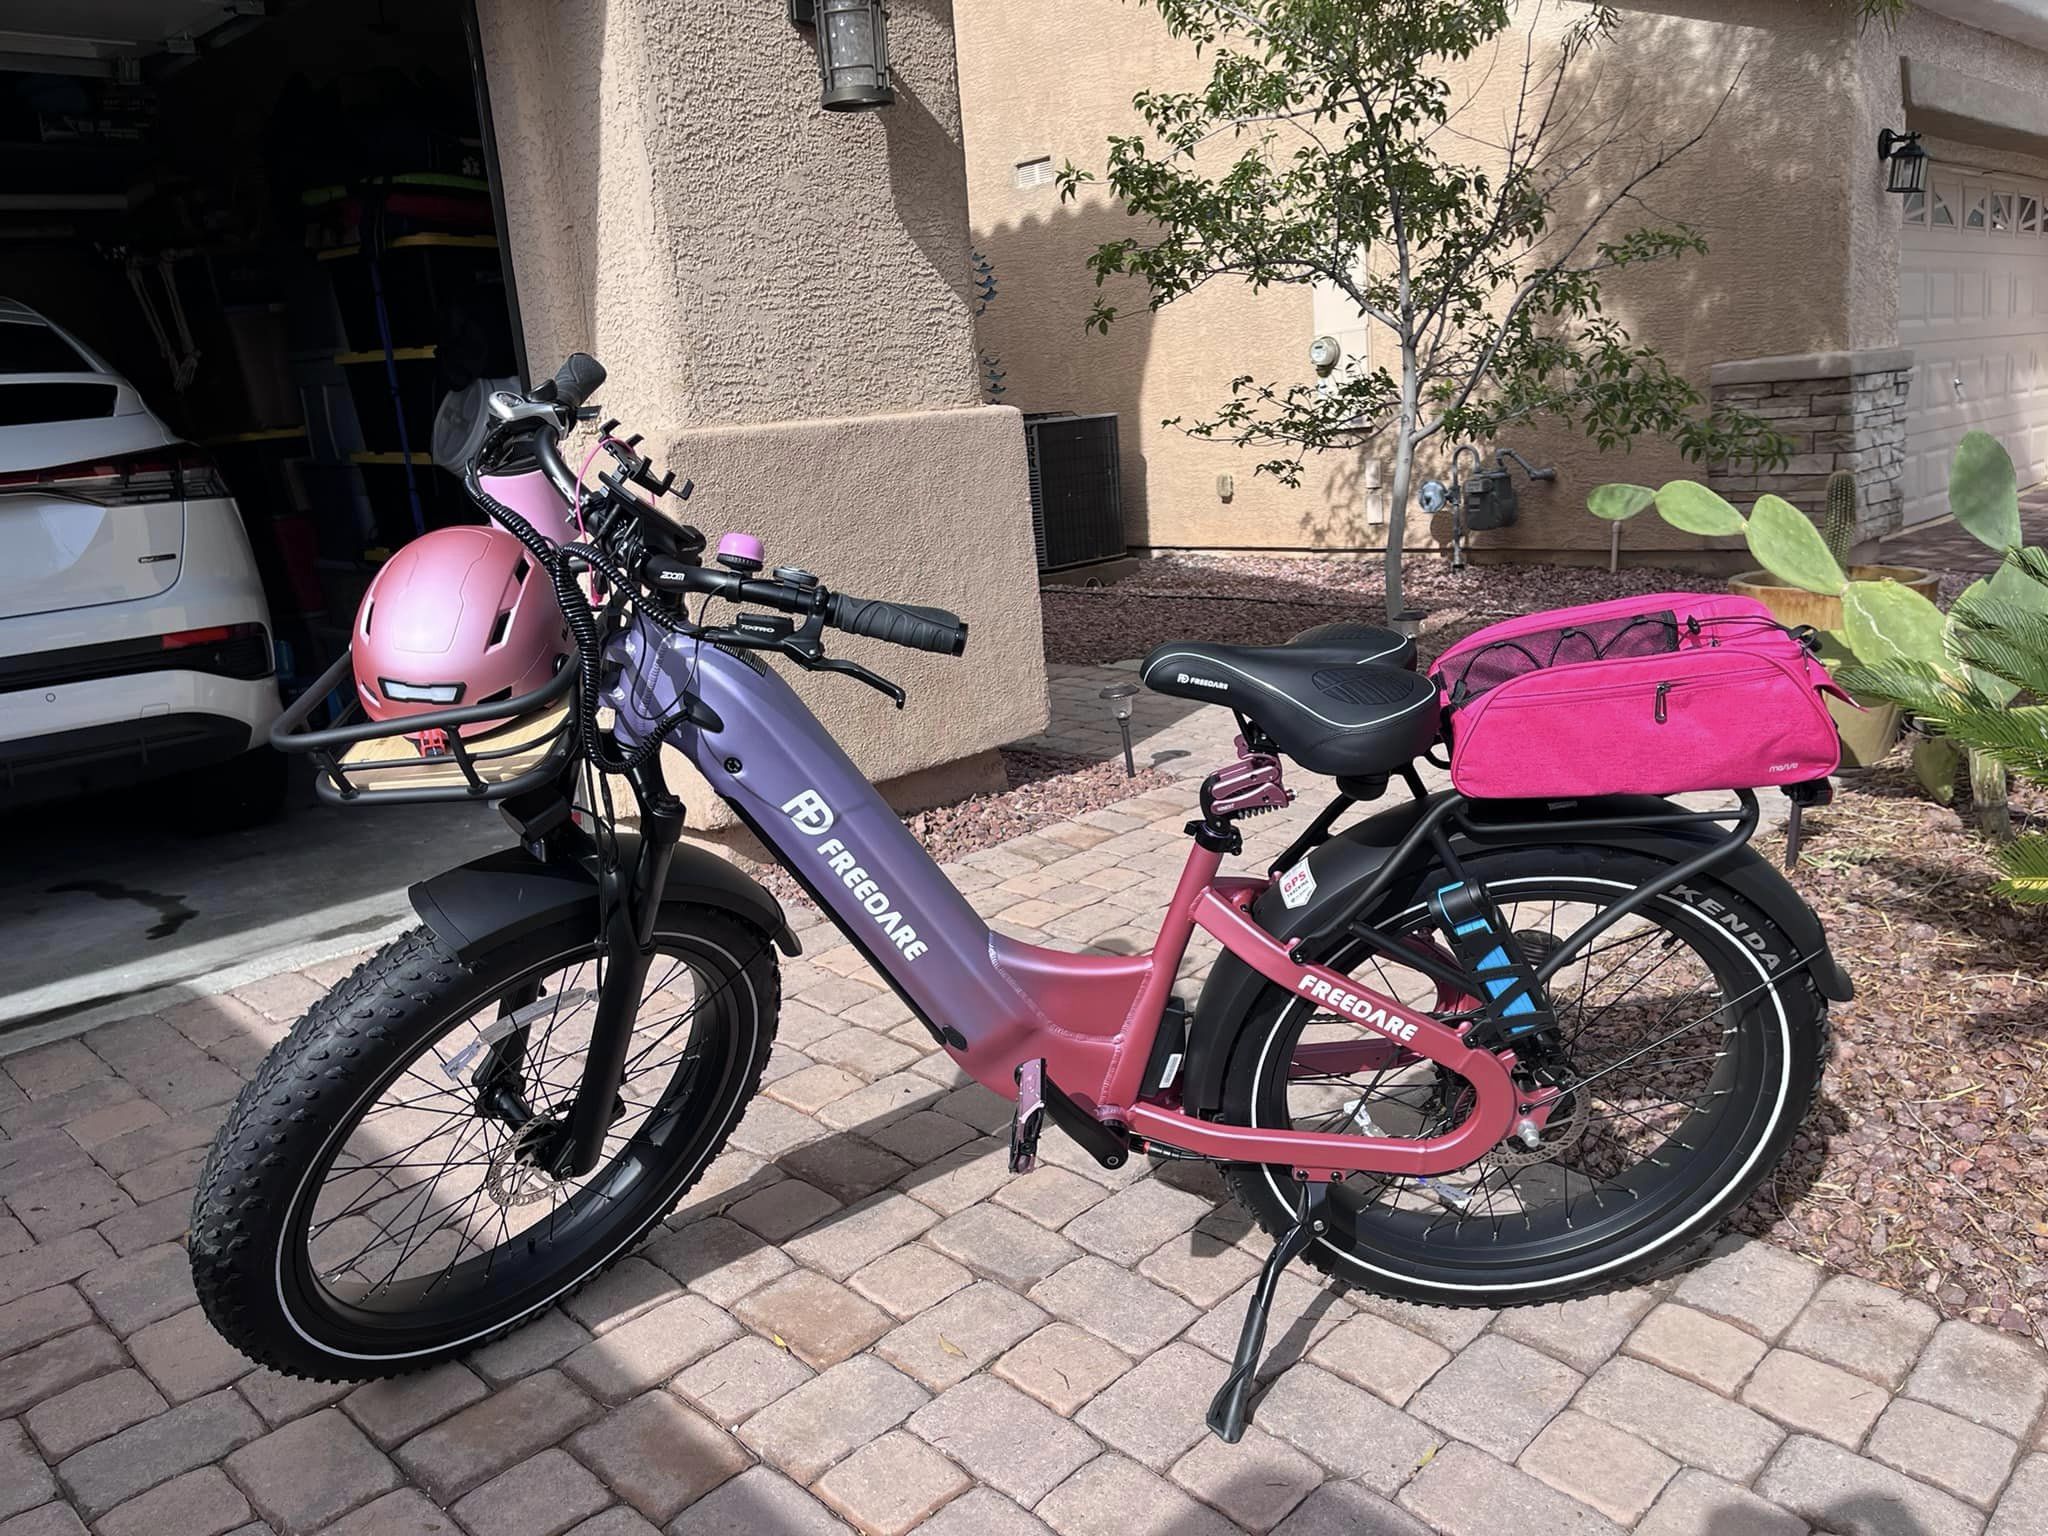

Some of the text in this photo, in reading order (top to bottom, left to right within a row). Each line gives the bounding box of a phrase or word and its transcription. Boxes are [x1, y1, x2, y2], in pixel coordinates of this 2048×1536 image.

[660, 571, 685, 581] ZOOM
[740, 623, 775, 633] TEKTRO
[1190, 677, 1228, 690] FREEDARE
[1284, 870, 1306, 893] GPS
[816, 838, 928, 961] FREEDARE
[1670, 884, 1780, 971] KENDA
[1298, 974, 1418, 1041] FREEDARE
